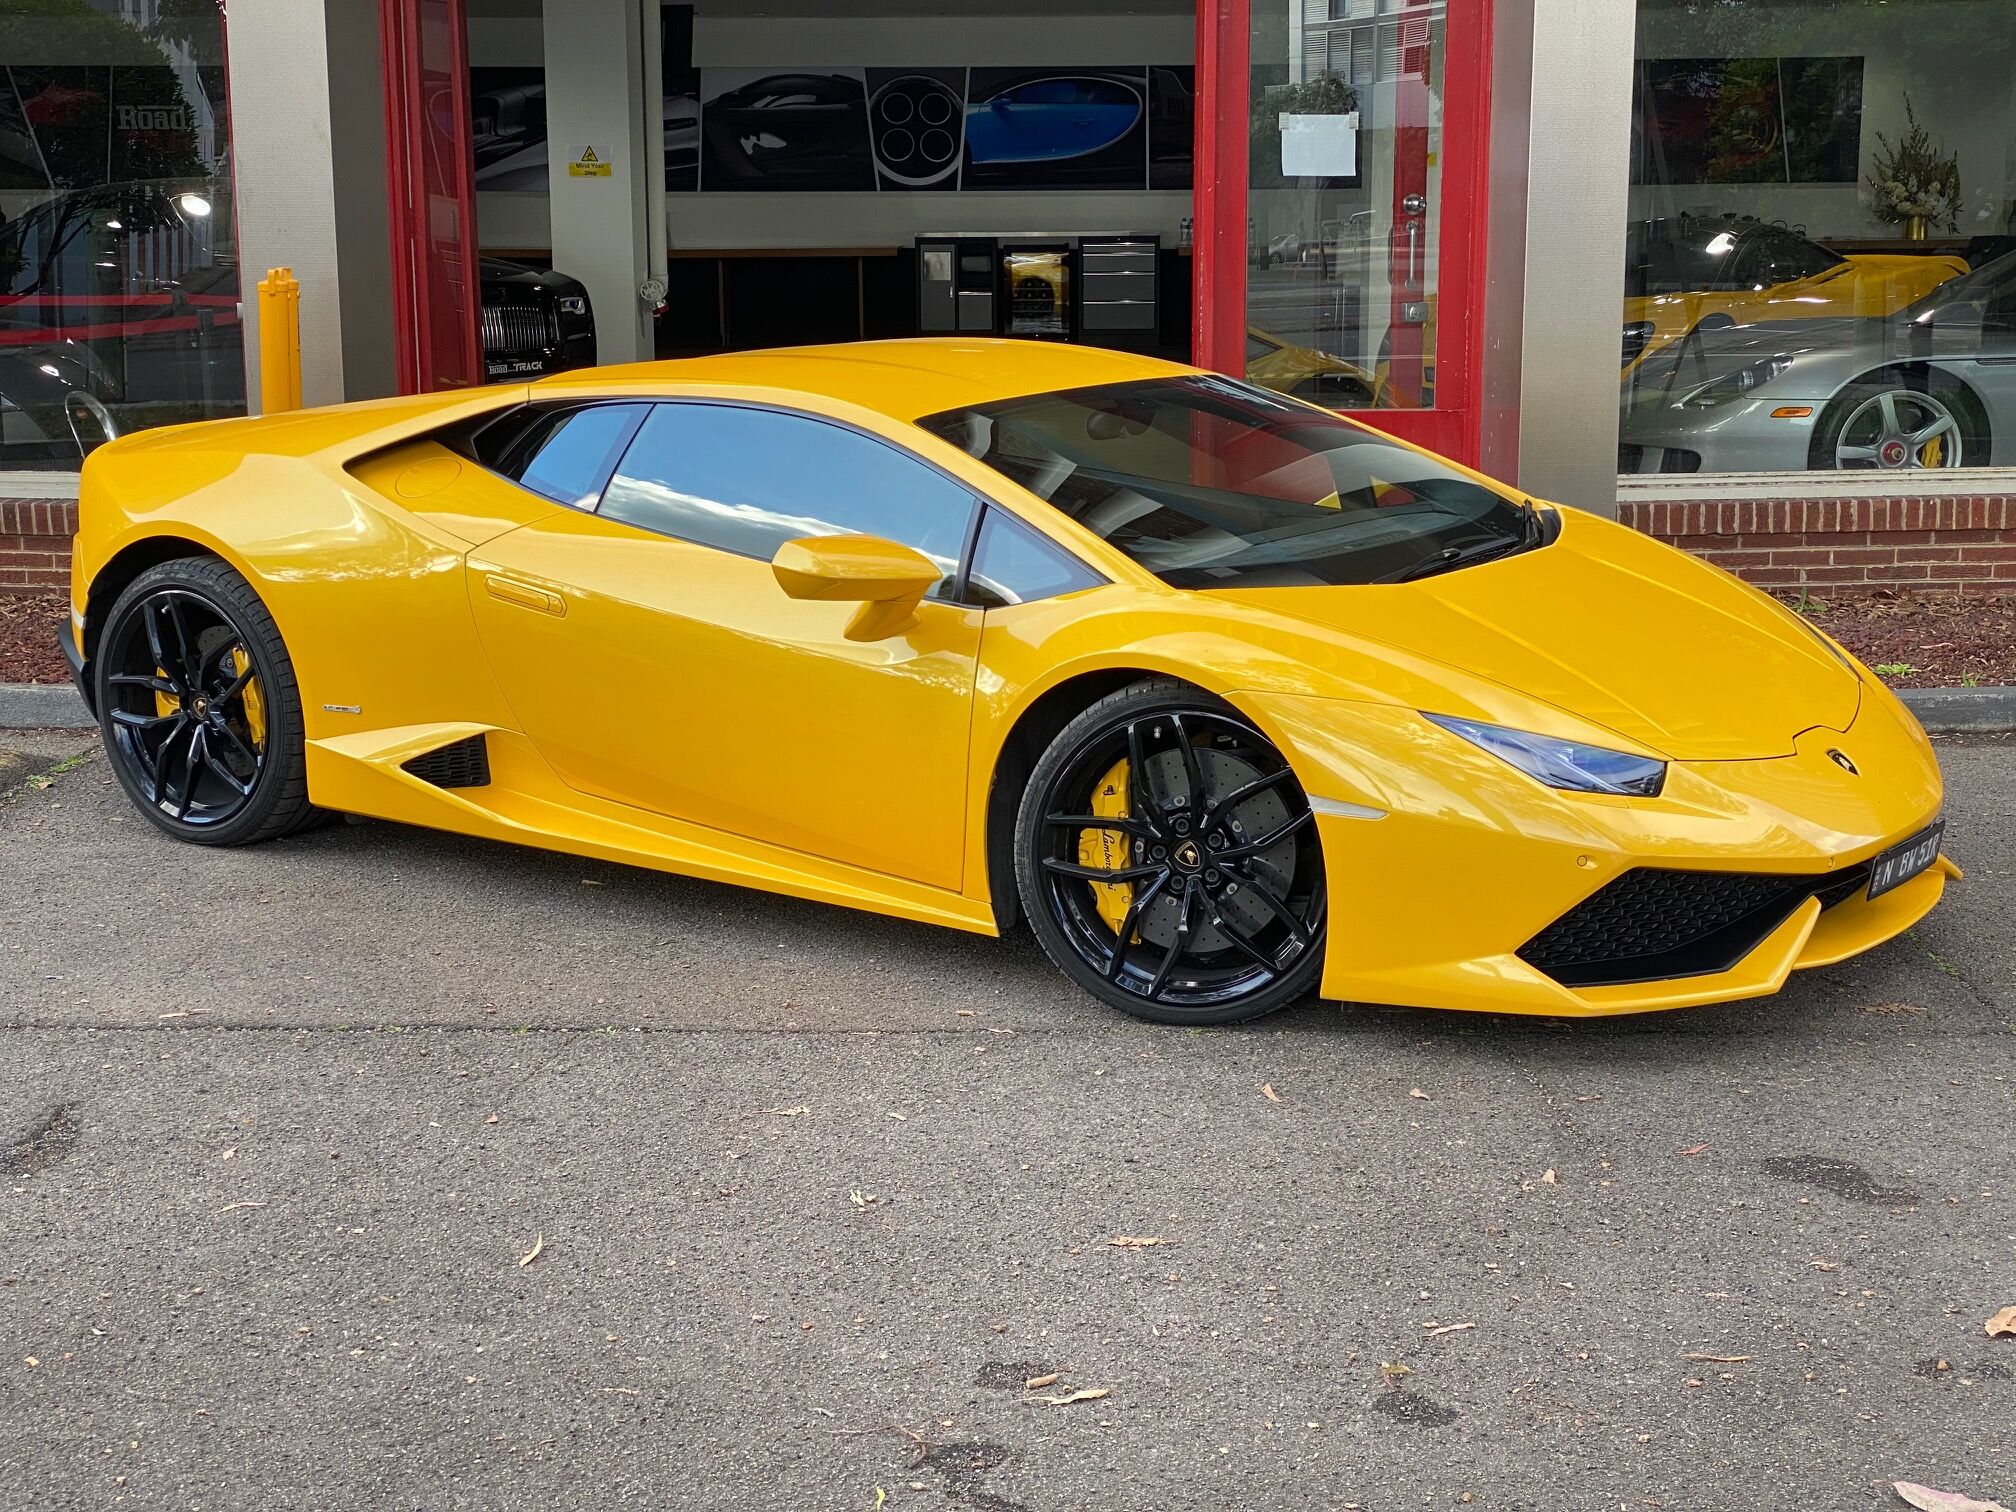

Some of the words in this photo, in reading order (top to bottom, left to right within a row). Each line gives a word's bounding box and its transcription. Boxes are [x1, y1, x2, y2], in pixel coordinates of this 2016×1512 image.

[116, 105, 188, 130] Road
[512, 361, 543, 371] TRACK
[1881, 858, 1895, 886] N
